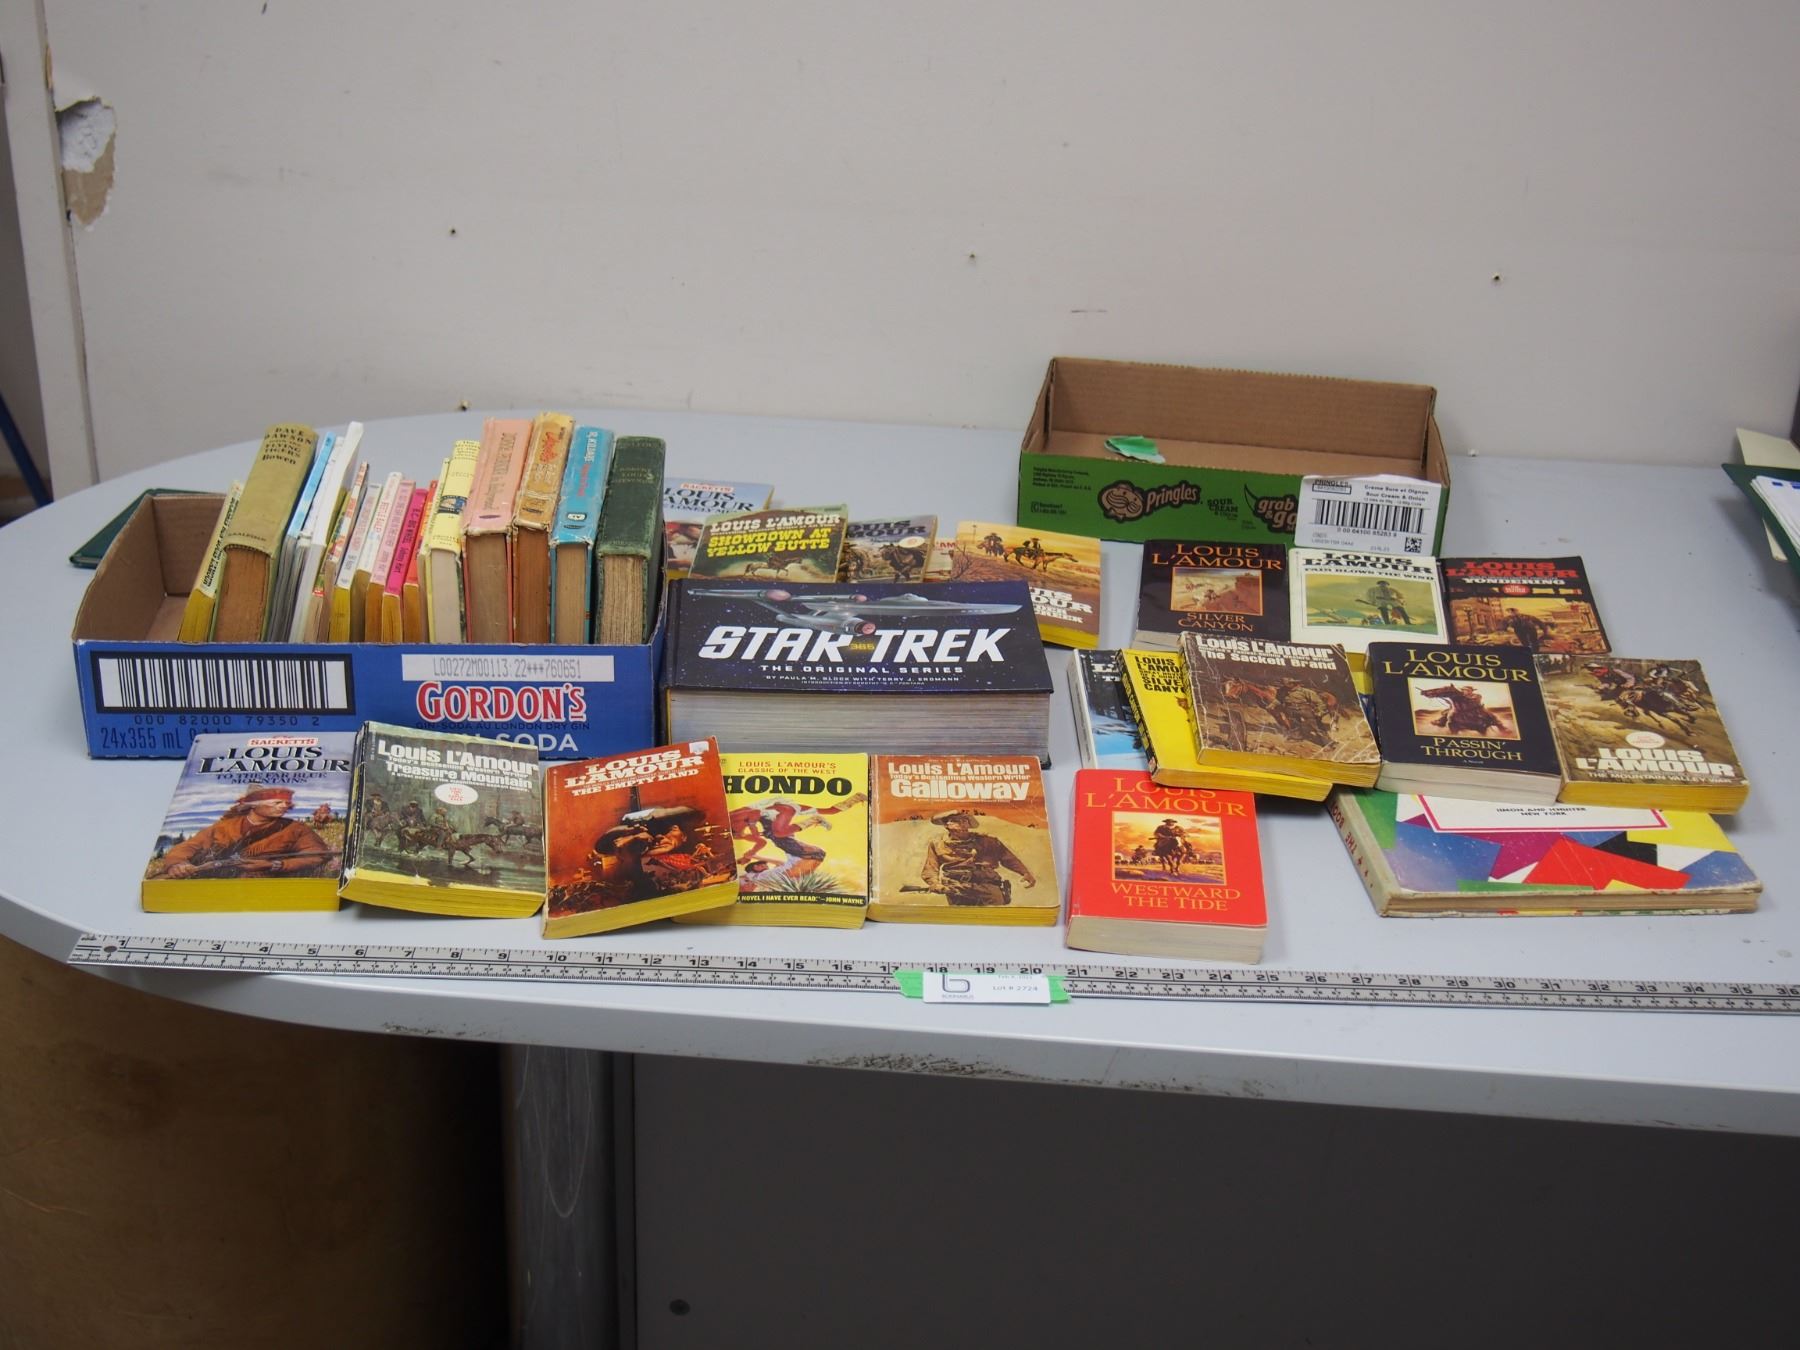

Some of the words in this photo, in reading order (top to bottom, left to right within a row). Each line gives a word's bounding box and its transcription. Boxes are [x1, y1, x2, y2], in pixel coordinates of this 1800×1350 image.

[1145, 484, 1199, 513] Pringles
[1257, 497, 1296, 514] grab
[711, 519, 763, 533] LOUIS
[765, 514, 841, 528] L'AMOUR
[1264, 510, 1275, 520] &
[709, 530, 806, 547] SHOWDOWN
[809, 527, 832, 539] AT
[707, 542, 773, 558] YELLOW
[774, 538, 831, 552] BUTTE
[1177, 543, 1260, 559] LOUIS
[1152, 553, 1286, 570] L'AMOUR
[1303, 558, 1433, 573] L'AMOUR
[1323, 552, 1413, 565] LOUIS
[1464, 561, 1556, 571] LOUIS
[1446, 568, 1578, 578] L'AMOUR
[1462, 577, 1566, 585] YONDERING
[1178, 619, 1256, 632] CANYON
[1186, 613, 1247, 624] SILVER
[697, 625, 856, 662] STAR
[870, 627, 1012, 663] TREK
[1195, 633, 1252, 653] Louis
[1250, 640, 1334, 660] L'Amour
[1135, 655, 1176, 666] LOUIS
[1200, 649, 1227, 661] The
[1230, 651, 1286, 667] Sackett
[1290, 657, 1337, 671] Brand
[1407, 649, 1502, 667] LOUIS
[802, 666, 891, 674] ORIGINAL
[1381, 660, 1532, 682] L'AMOUR
[1142, 676, 1183, 687] SILVE
[416, 682, 587, 722] GORDON'S
[134, 714, 166, 726] 000
[179, 715, 233, 727] 82000
[246, 716, 299, 727] 79350
[311, 716, 322, 727] 2
[476, 722, 491, 730] AU
[494, 722, 542, 730] LONDON
[545, 722, 567, 730] DRY
[570, 722, 591, 731] GIN
[101, 728, 156, 751] 24x355
[162, 730, 182, 750] mL
[250, 738, 316, 746] SACKETTS
[1433, 737, 1507, 750] PASSIN'
[228, 746, 324, 759] LOUIS
[378, 739, 442, 763] Louis
[446, 748, 540, 777] L'Amour
[1421, 746, 1522, 761] THROUGH
[1598, 747, 1704, 761] LOUIS
[200, 756, 352, 773] L'AMOUR
[584, 748, 683, 776] LOUIS
[739, 760, 771, 768] LOUIS
[777, 760, 838, 770] L'AMOUR'S
[888, 761, 943, 777] Louis
[946, 761, 1030, 778] L'Amour
[1575, 757, 1735, 778] L'AMOUR
[215, 771, 233, 780] TO
[234, 771, 263, 780] THE
[265, 772, 290, 780] FAR
[292, 771, 328, 780] BLUE
[386, 760, 458, 780] Treasure
[460, 769, 533, 790] Mountain
[564, 755, 706, 789] L'AMOUR
[967, 774, 1004, 782] Western
[571, 782, 602, 797] THE
[605, 774, 657, 792] EMPTY
[658, 767, 700, 782] LAND
[722, 774, 853, 796] HONDO
[891, 779, 1030, 802] Galloway
[1084, 792, 1248, 817] L'AMOUR
[1110, 882, 1241, 900] WESTWARD
[843, 896, 865, 904] WAYNE
[1124, 895, 1160, 909] THE
[1165, 897, 1236, 911] TIDE
[118, 939, 127, 947] 1
[163, 941, 174, 949] 2
[210, 943, 221, 951] 3
[258, 946, 269, 954] 4
[307, 948, 318, 956] 5
[354, 948, 365, 957] 6
[403, 950, 413, 958] 7
[449, 951, 460, 959] 8
[497, 952, 508, 960] 9
[546, 954, 568, 962] 10
[594, 956, 614, 964] 11
[641, 957, 663, 965] 12
[690, 959, 710, 967] 13
[784, 962, 806, 970] 15
[832, 963, 853, 972] 16
[927, 966, 948, 974] 18
[973, 966, 996, 974] 19
[1019, 967, 1042, 975] 20
[1067, 968, 1088, 976] 21
[1115, 970, 1137, 979] 22
[1162, 972, 1184, 980] 23
[1209, 973, 1232, 981] 24
[1256, 974, 1279, 982] 25
[1304, 975, 1327, 984] 26
[1351, 976, 1373, 985] 27
[1398, 978, 1421, 986] 28
[1446, 979, 1469, 987] 29
[1492, 980, 1516, 989] 30
[1540, 982, 1561, 991] 31
[1587, 984, 1610, 992] 32
[1635, 985, 1658, 993] 33
[1682, 986, 1706, 994] 34
[1730, 988, 1753, 996] 35
[1777, 989, 1800, 997] 36
